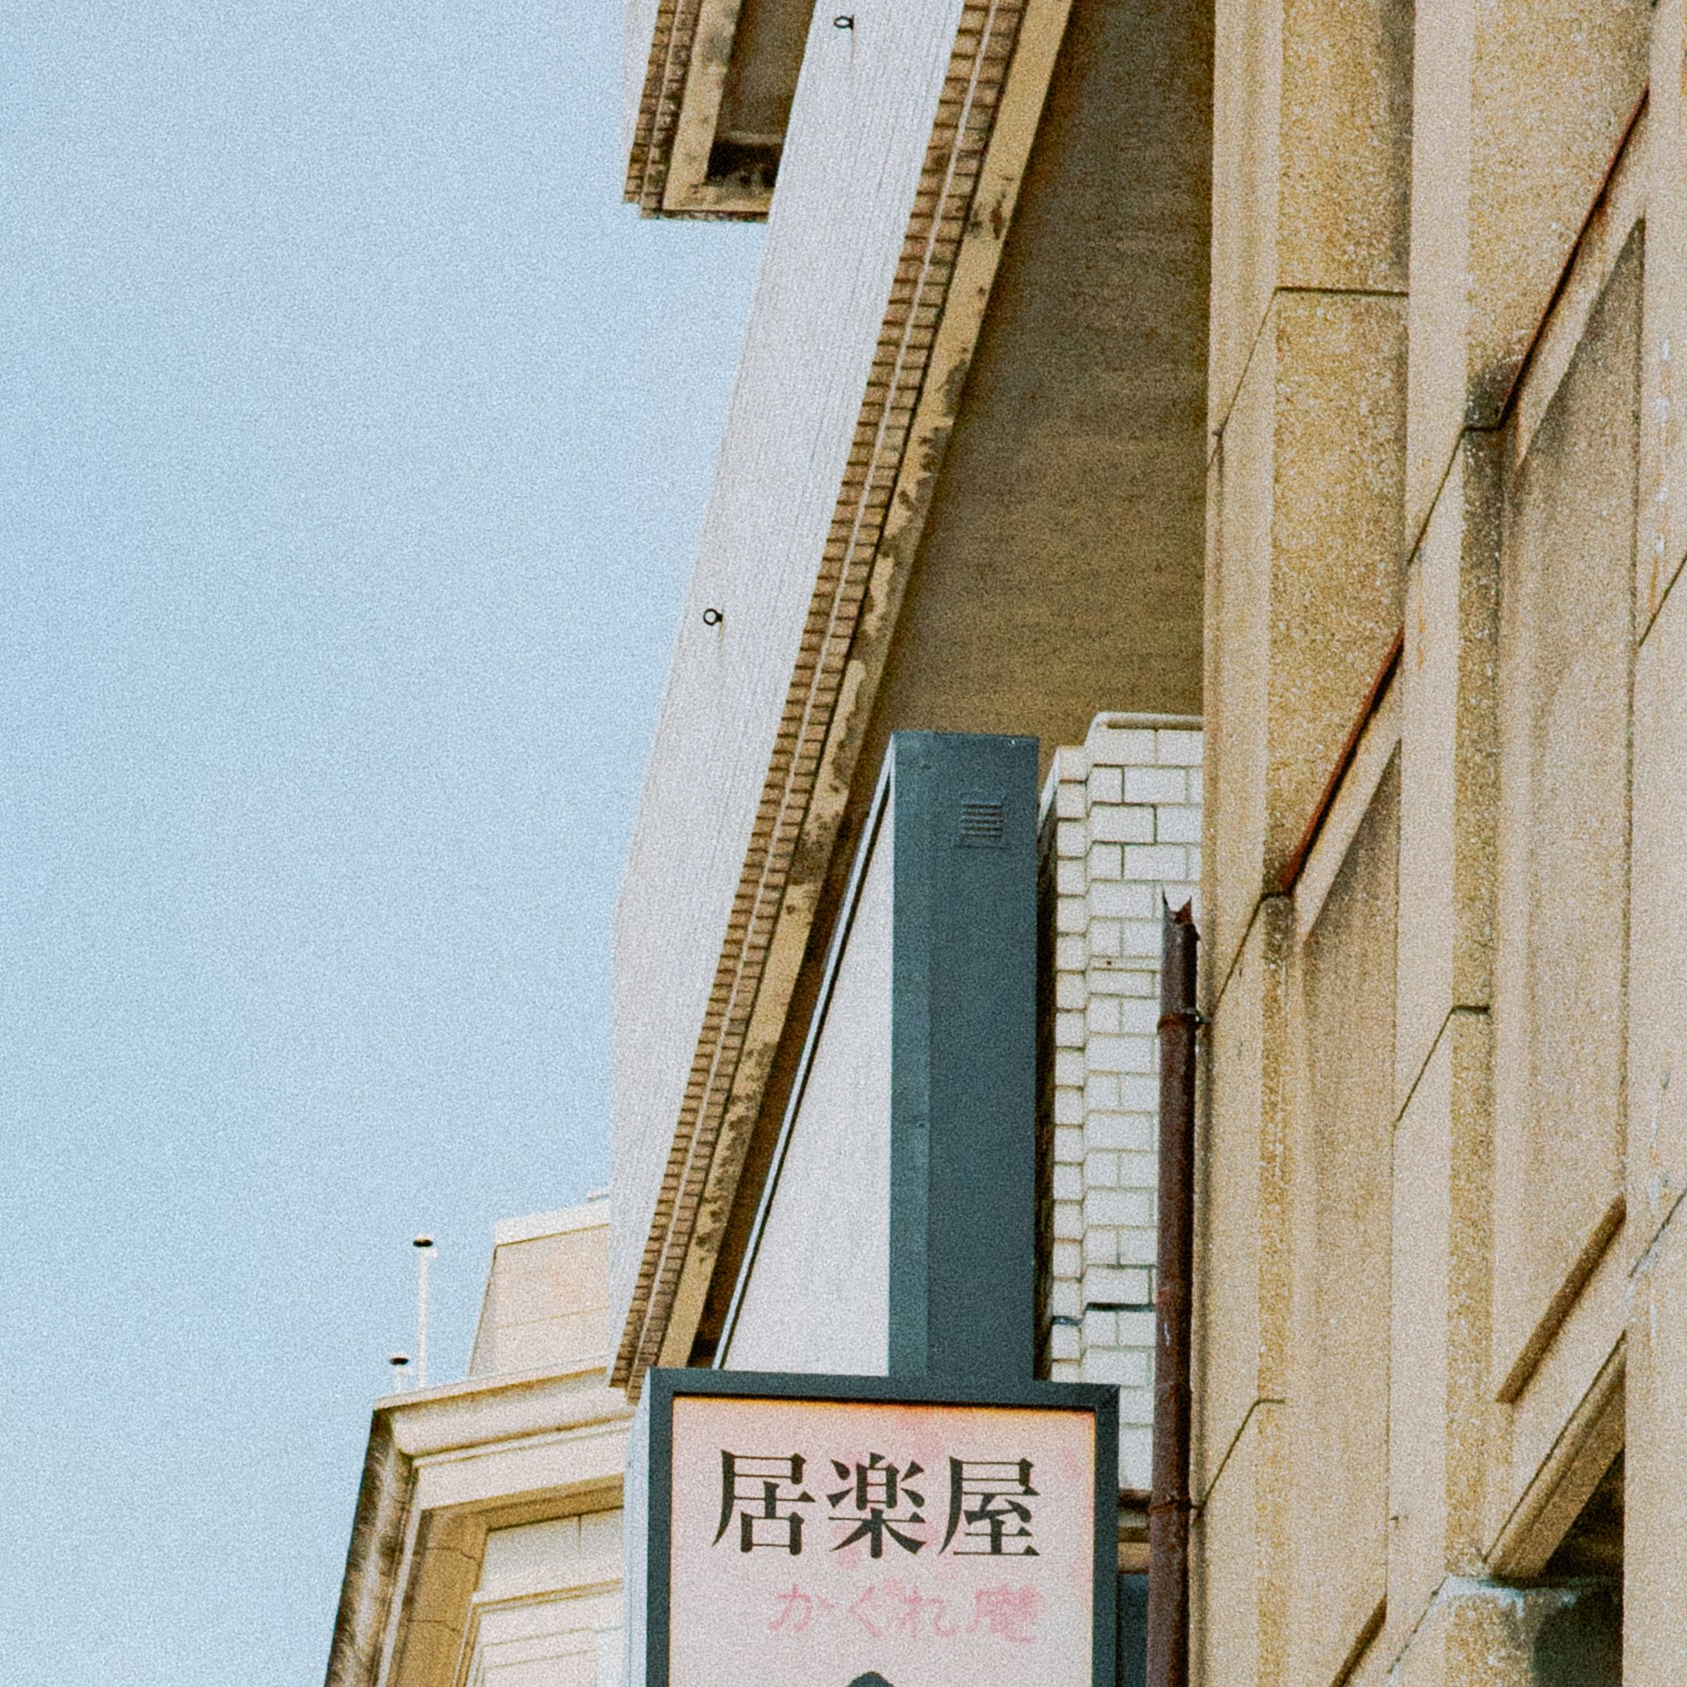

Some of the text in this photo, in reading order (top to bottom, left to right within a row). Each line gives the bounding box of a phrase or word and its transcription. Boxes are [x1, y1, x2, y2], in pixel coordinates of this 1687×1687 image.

[712, 1448, 1041, 1560] 居楽屋
[767, 1582, 1049, 1645] かくれ庵
